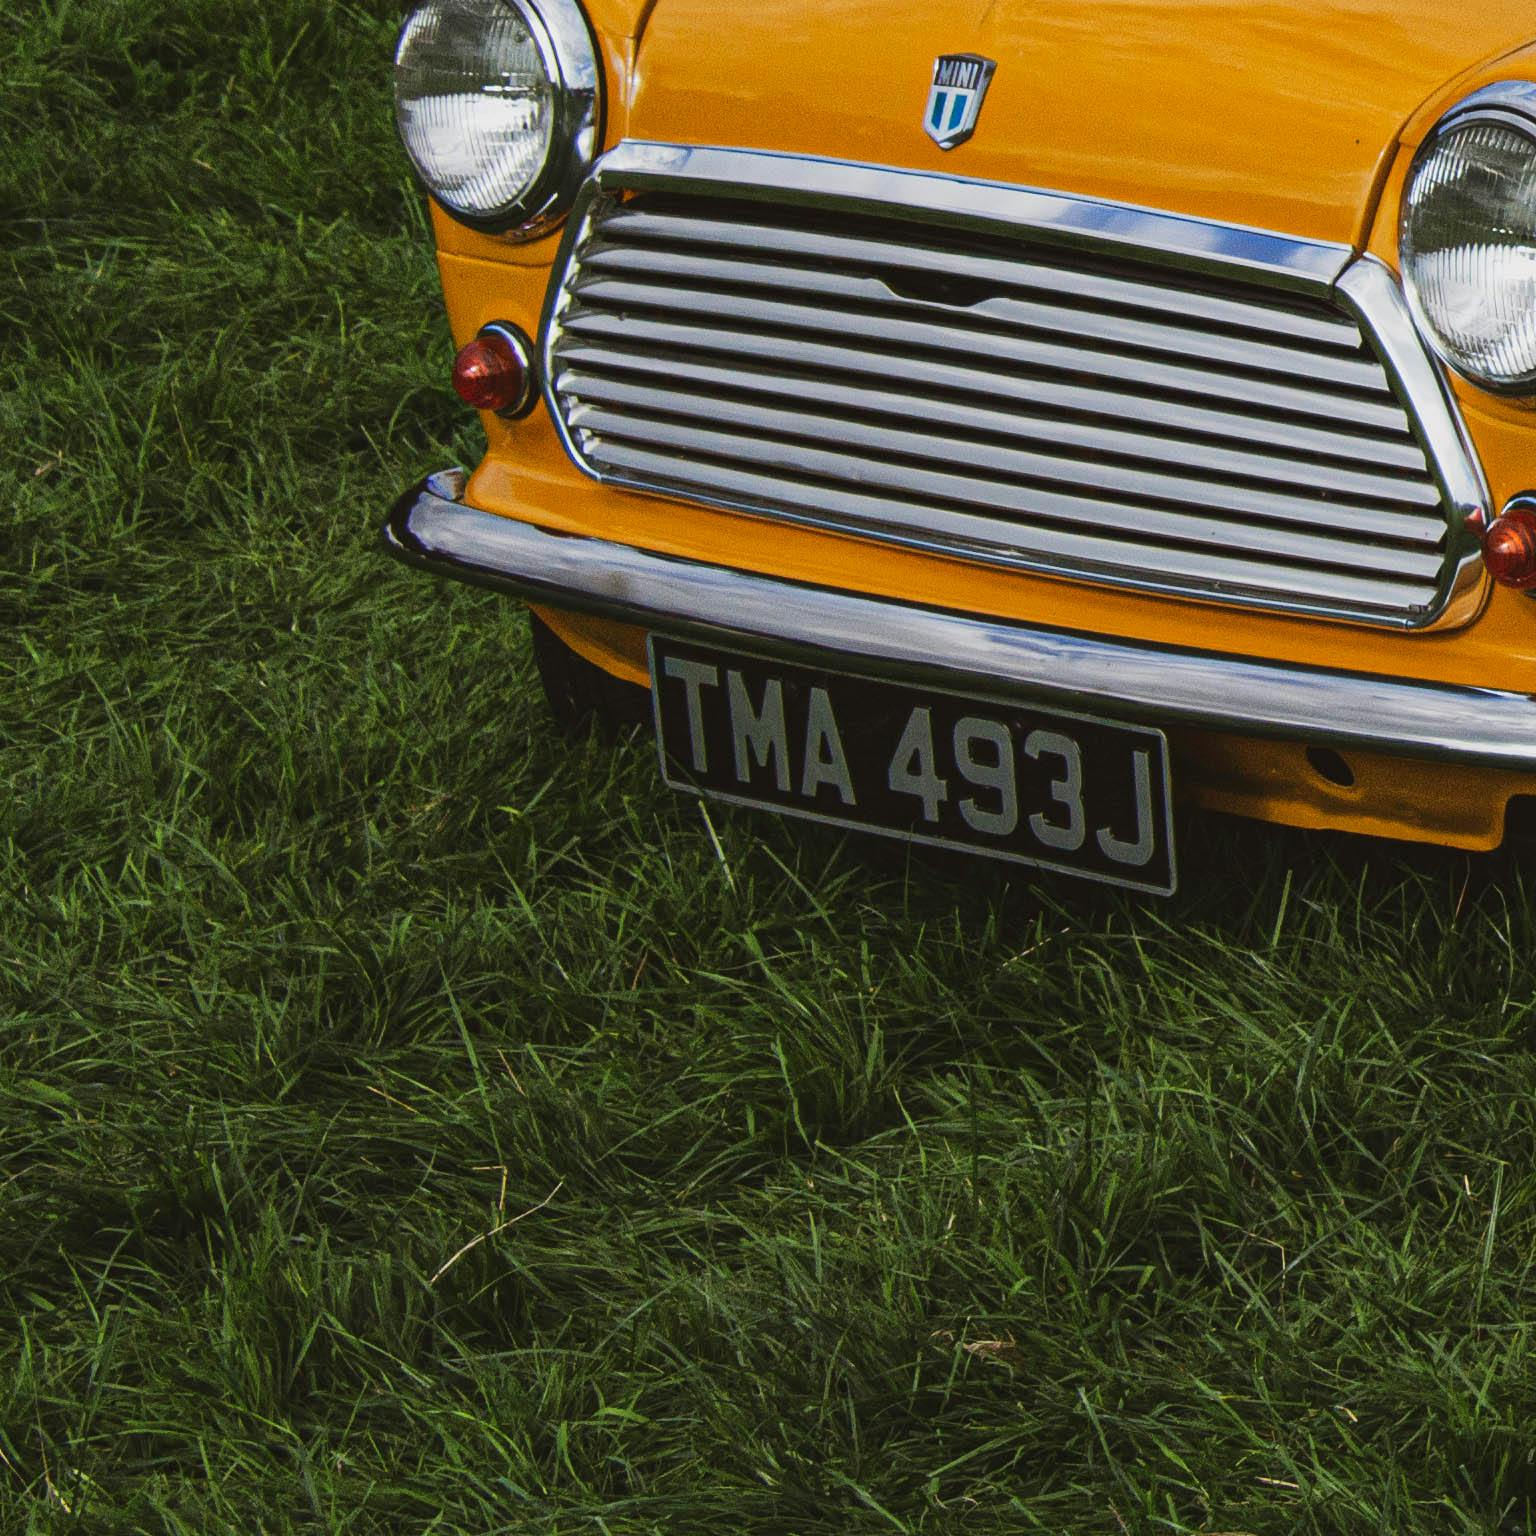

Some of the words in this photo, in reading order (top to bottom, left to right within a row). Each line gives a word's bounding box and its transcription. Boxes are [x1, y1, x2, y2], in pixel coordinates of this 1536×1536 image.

[938, 60, 979, 90] MINI
[664, 655, 857, 806] TMA
[887, 706, 1155, 866] 493J
